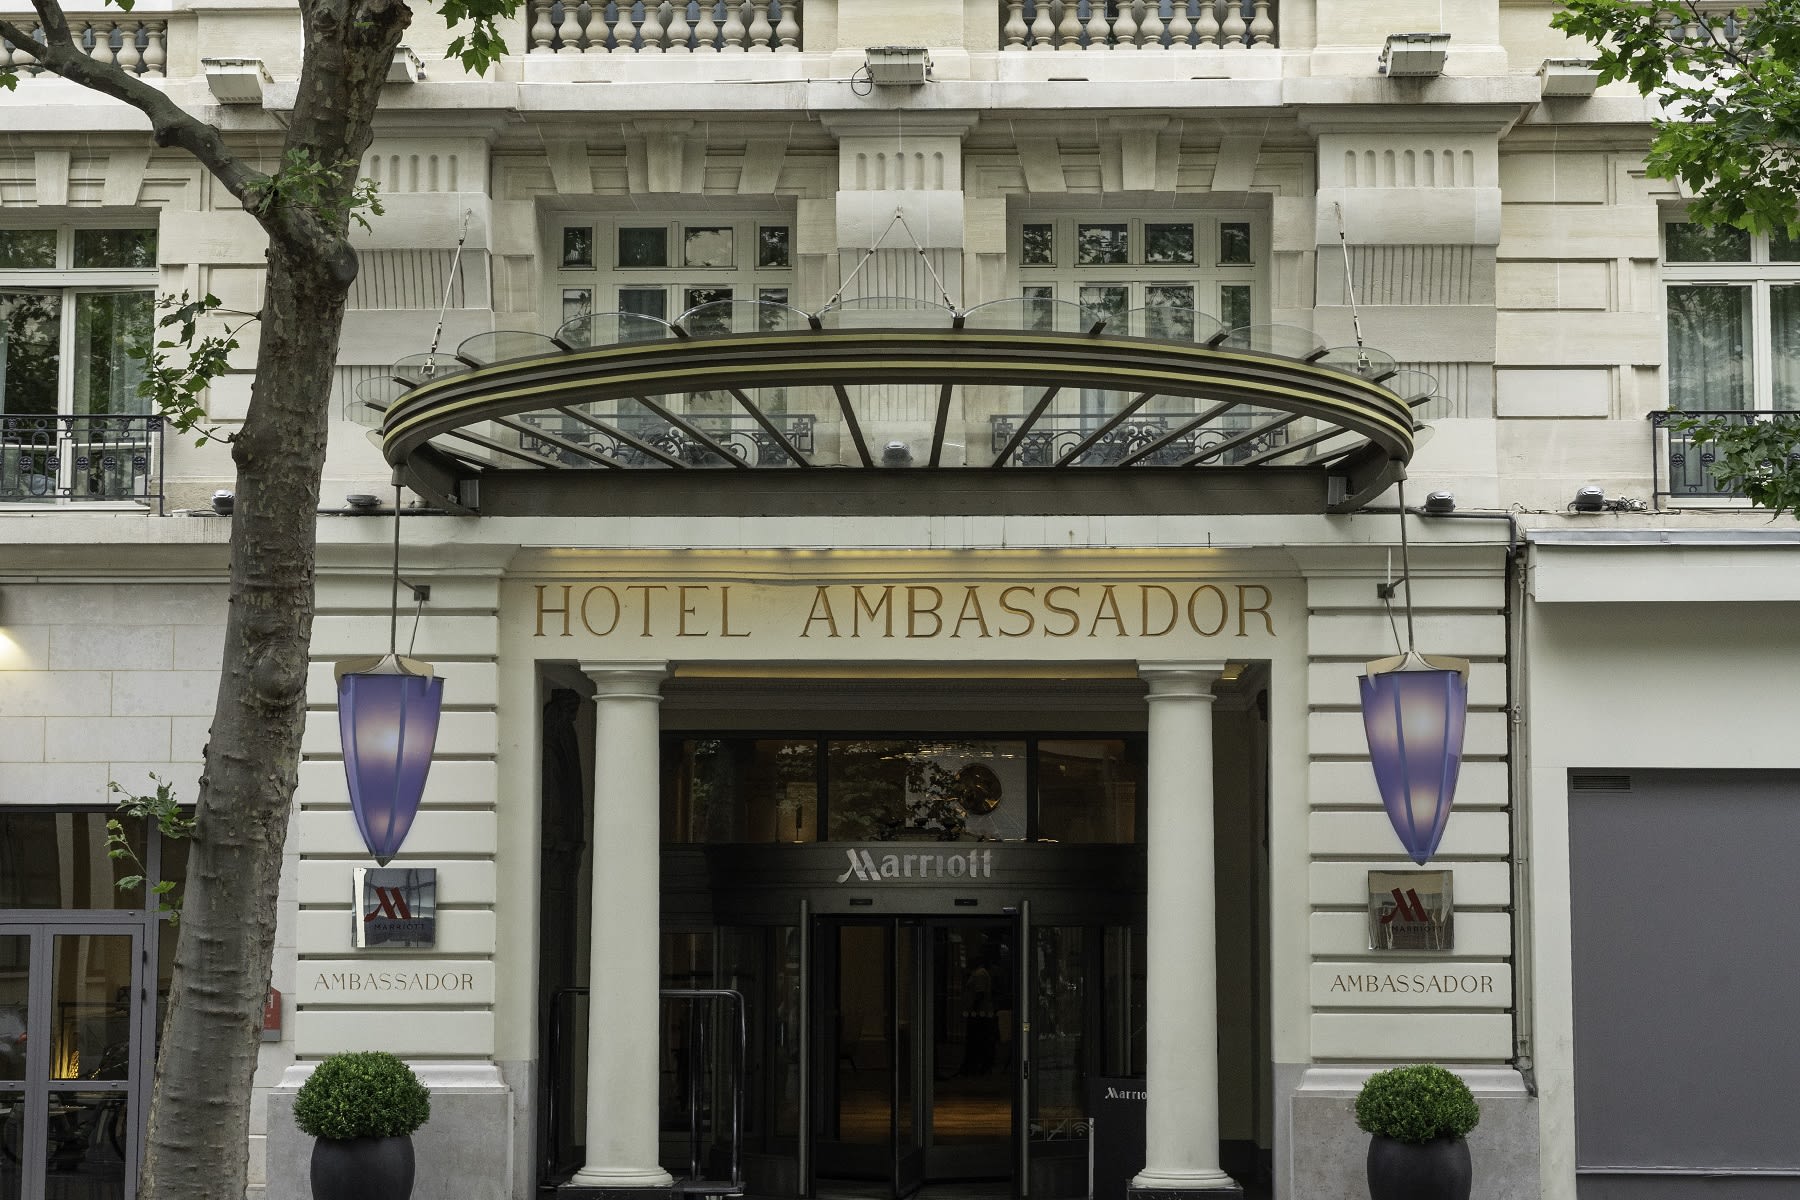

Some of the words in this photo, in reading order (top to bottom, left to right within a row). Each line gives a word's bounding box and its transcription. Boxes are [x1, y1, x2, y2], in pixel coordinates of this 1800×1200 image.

[533, 584, 752, 638] HOTEL
[799, 584, 1277, 638] AMBASSADOR
[836, 848, 993, 883] Marriott
[314, 972, 474, 991] AMBASSADOR
[1330, 974, 1494, 993] AMBASSADOR
[1104, 1086, 1147, 1100] Marrio
